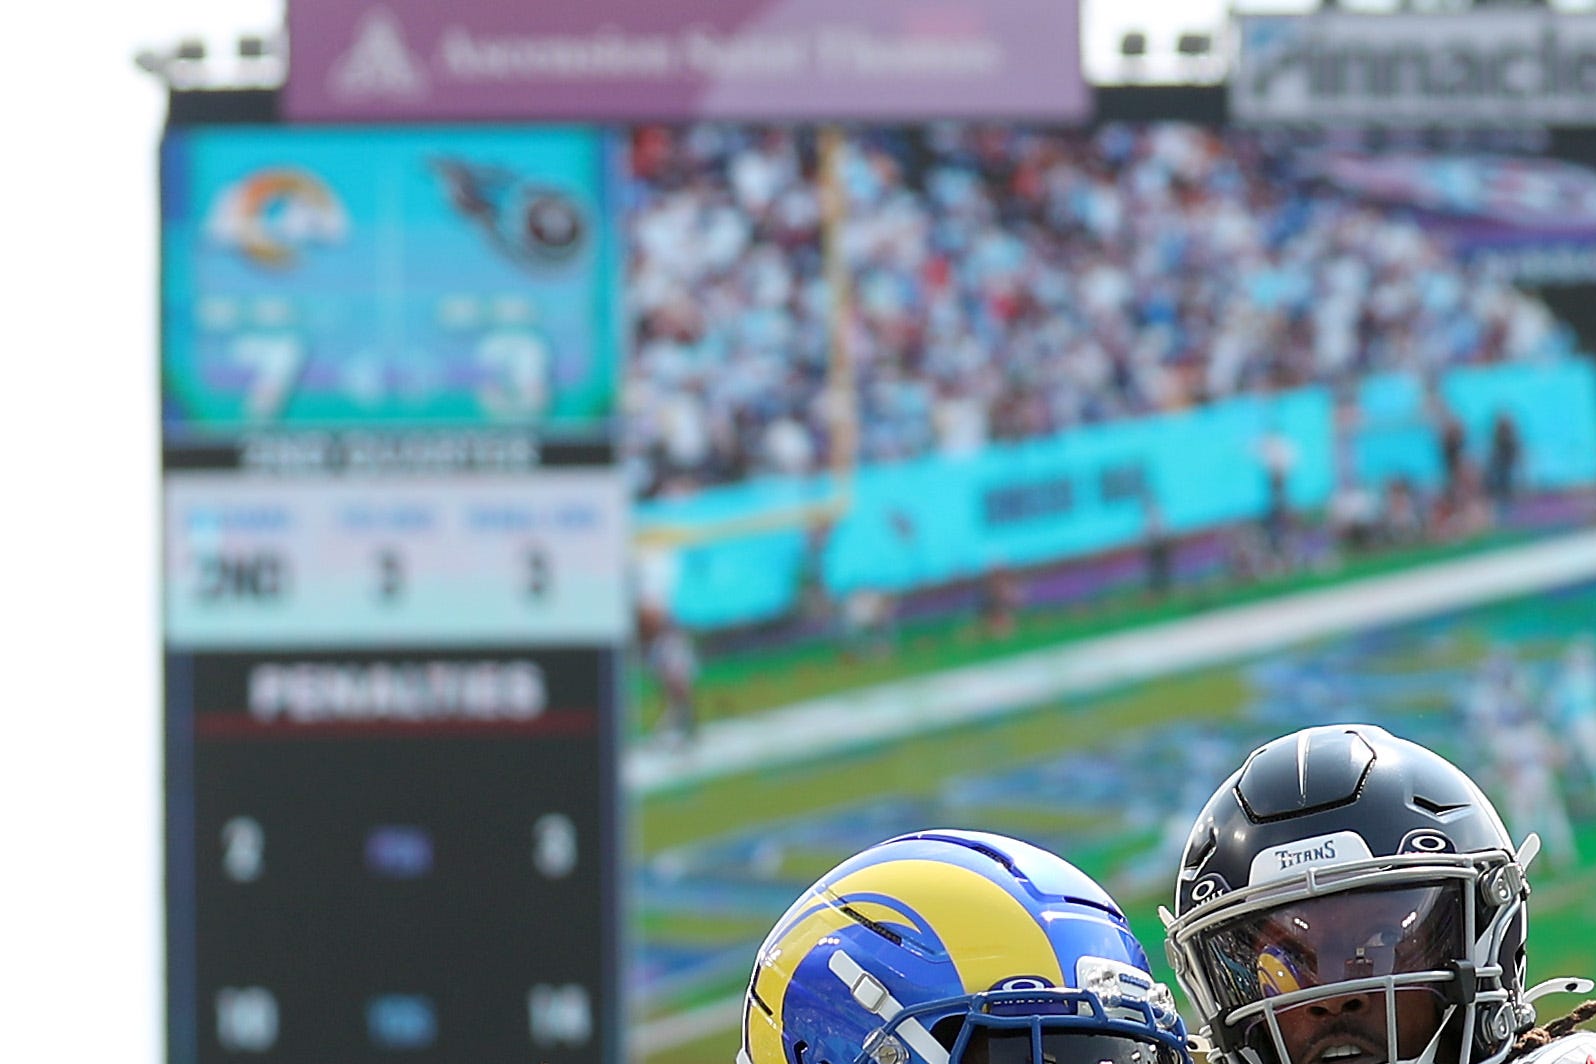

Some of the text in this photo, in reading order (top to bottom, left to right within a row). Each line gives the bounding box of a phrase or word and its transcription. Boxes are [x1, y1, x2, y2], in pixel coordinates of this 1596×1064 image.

[234, 337, 302, 426] 7
[476, 334, 552, 426] 3
[250, 661, 545, 719] PENALTIES
[1275, 840, 1337, 870] TITANS
